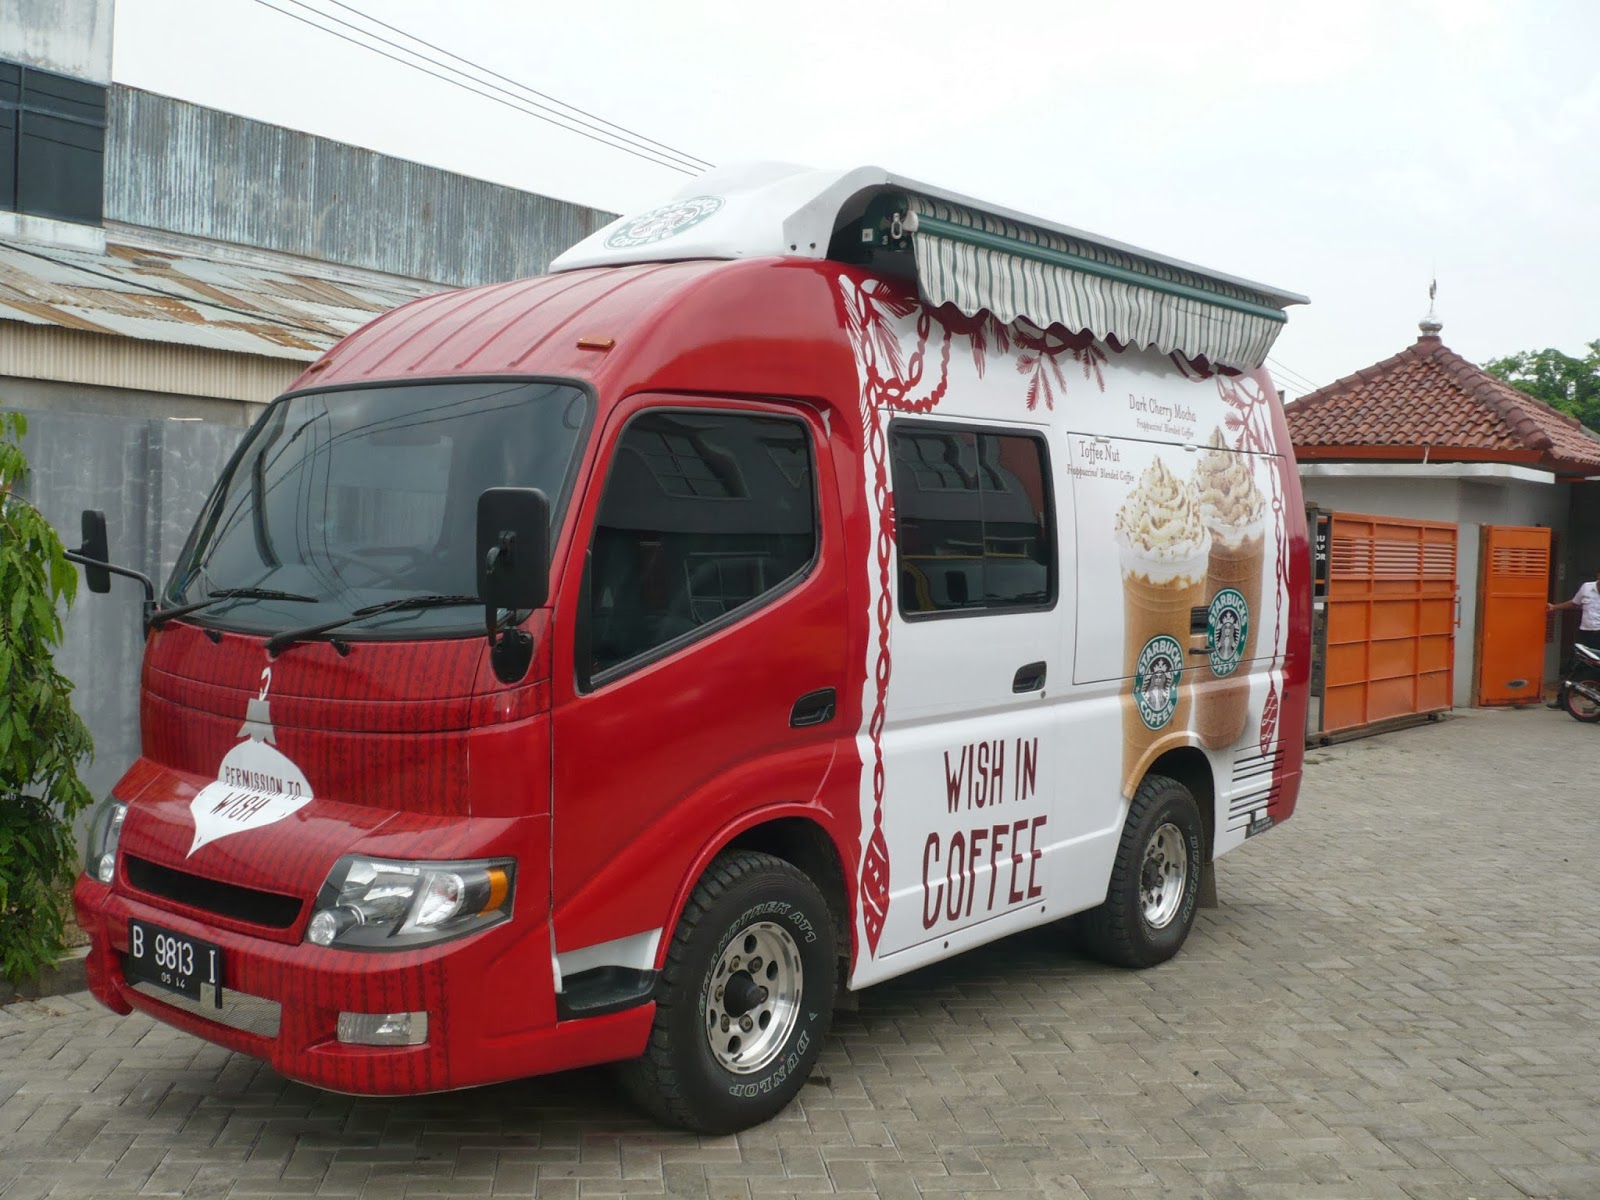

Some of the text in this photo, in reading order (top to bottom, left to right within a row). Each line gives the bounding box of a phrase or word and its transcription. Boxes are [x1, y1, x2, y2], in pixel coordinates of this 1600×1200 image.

[1128, 393, 1196, 422] Dark Cherry Mocha
[1079, 440, 1120, 465] Toffee Nut
[1208, 593, 1247, 627] STARBUCKS
[1138, 640, 1182, 675] STARBUCKS
[1210, 651, 1240, 674] COFFEE
[1140, 700, 1174, 725] COFFEE
[224, 765, 302, 800] PERMISSION TO
[944, 737, 1038, 814] WISH IN
[209, 792, 271, 822] WISH
[922, 815, 1047, 930] COFFEE
[133, 925, 216, 984] B 9813 I
[161, 972, 171, 984] 05
[729, 1030, 811, 1097] DUNLOP
